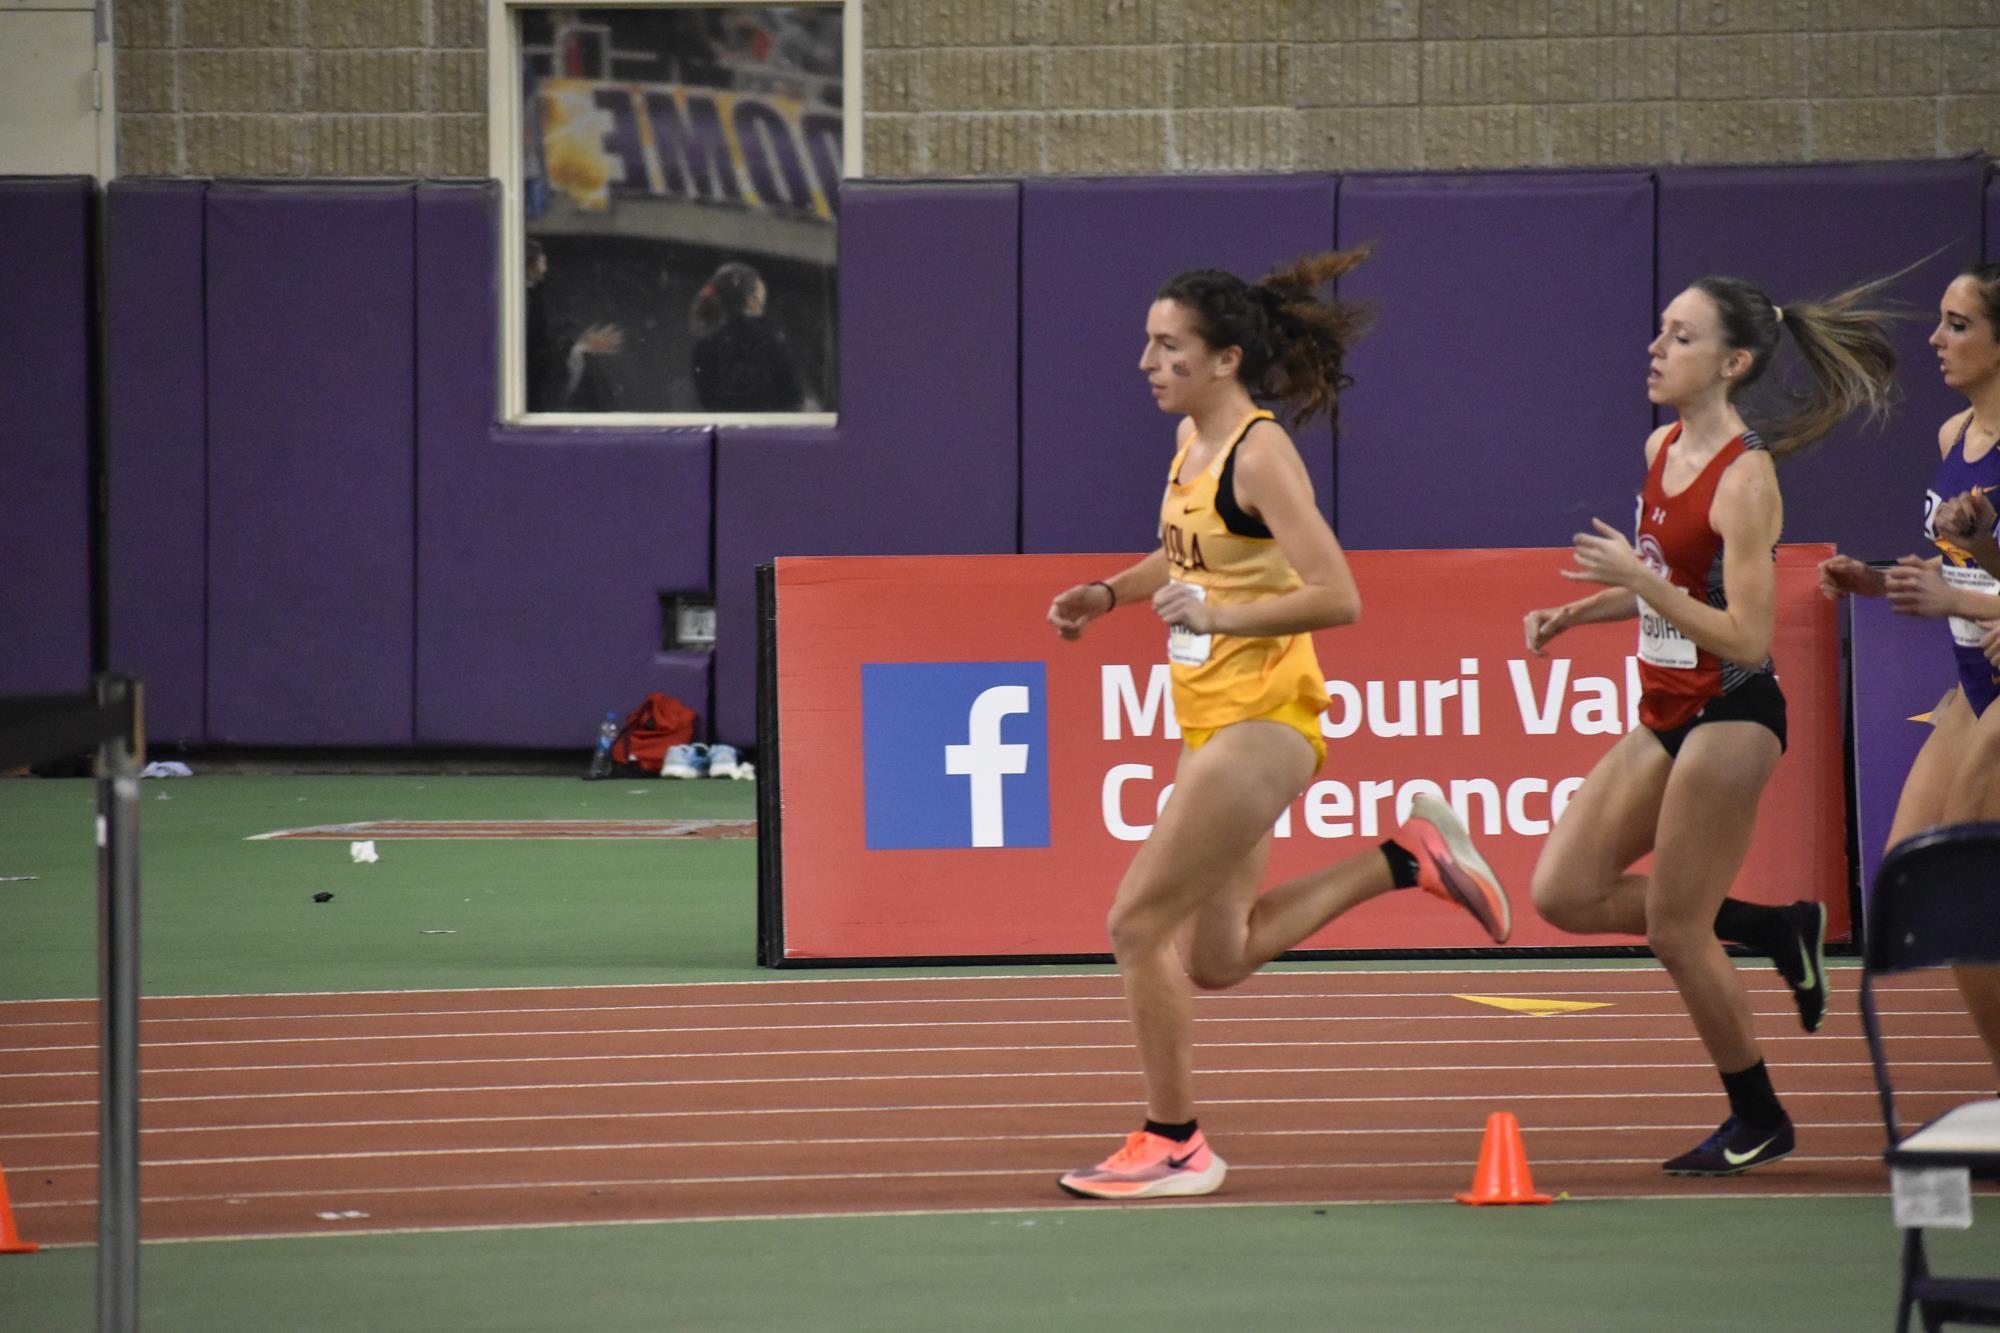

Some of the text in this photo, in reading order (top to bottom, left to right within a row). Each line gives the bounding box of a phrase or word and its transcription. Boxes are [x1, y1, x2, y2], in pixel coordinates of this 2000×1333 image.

[1164, 523, 1209, 572] OLA
[1101, 656, 1643, 740] Mouri Val
[945, 685, 1030, 848] f
[1102, 763, 1586, 841] Cerenc
